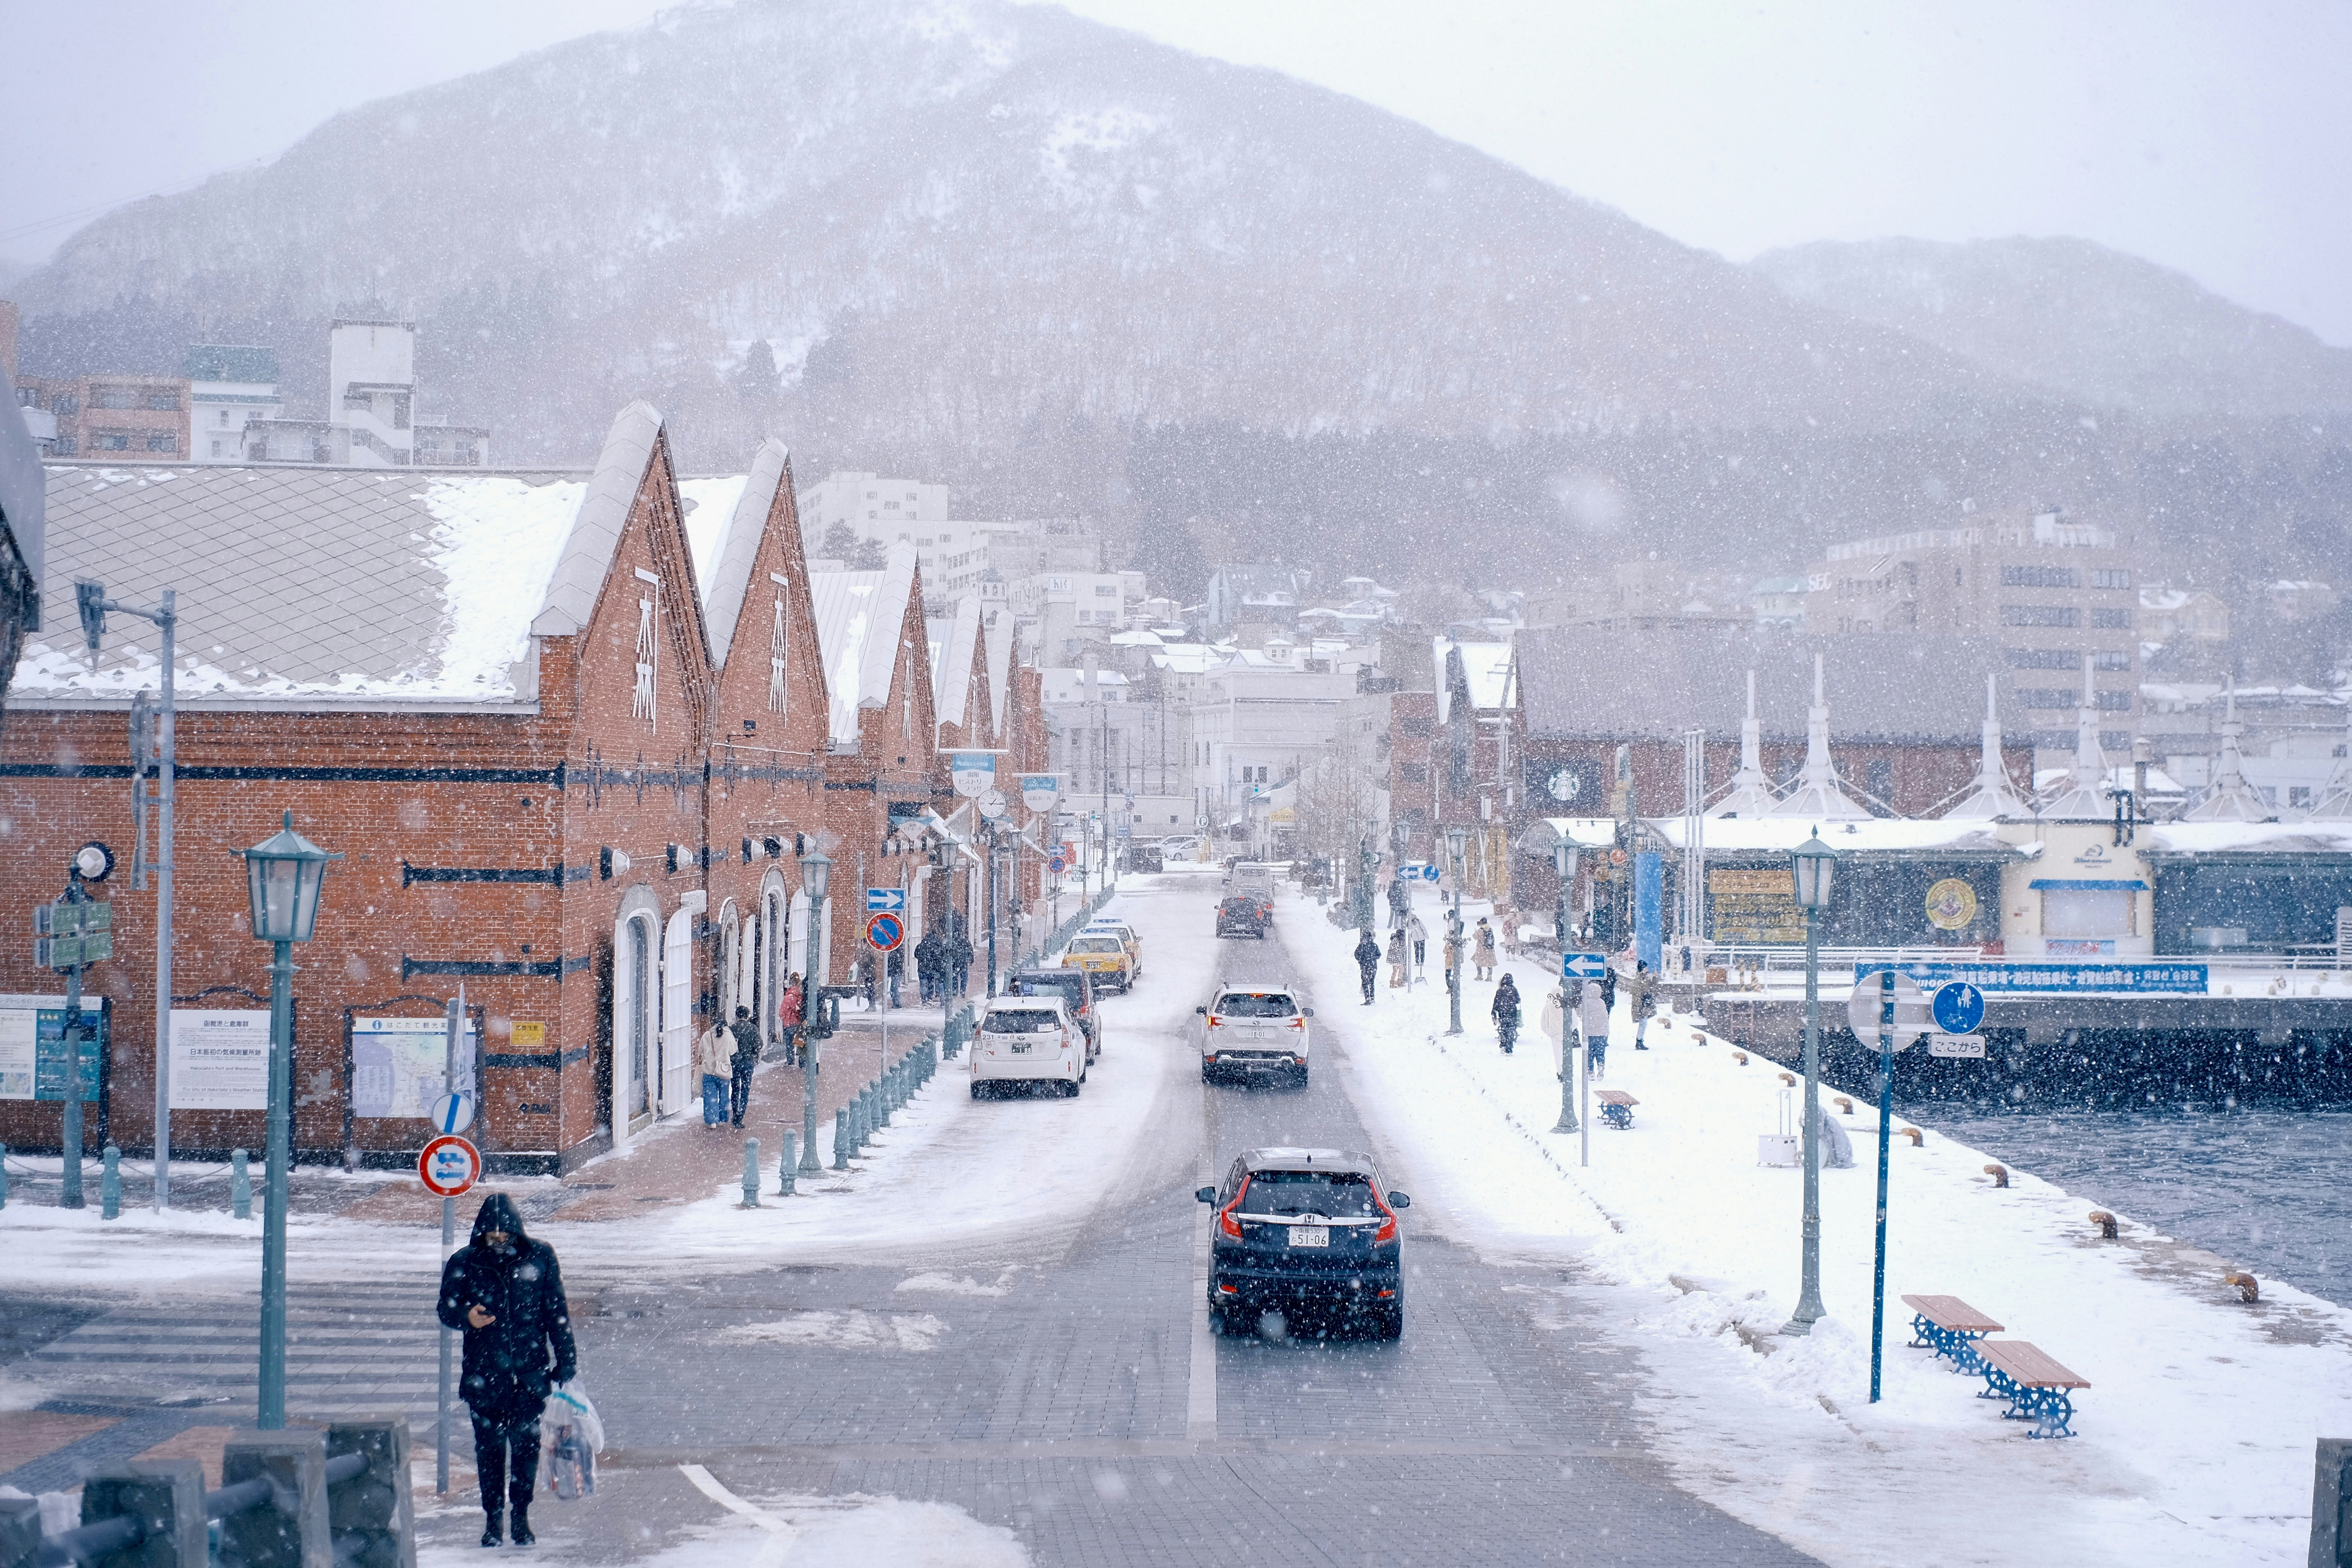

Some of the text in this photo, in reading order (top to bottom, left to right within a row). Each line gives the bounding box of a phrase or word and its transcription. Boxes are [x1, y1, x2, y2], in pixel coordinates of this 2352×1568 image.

[1936, 1042, 1981, 1053] ここから
[1298, 1234, 1326, 1245] 51-06
